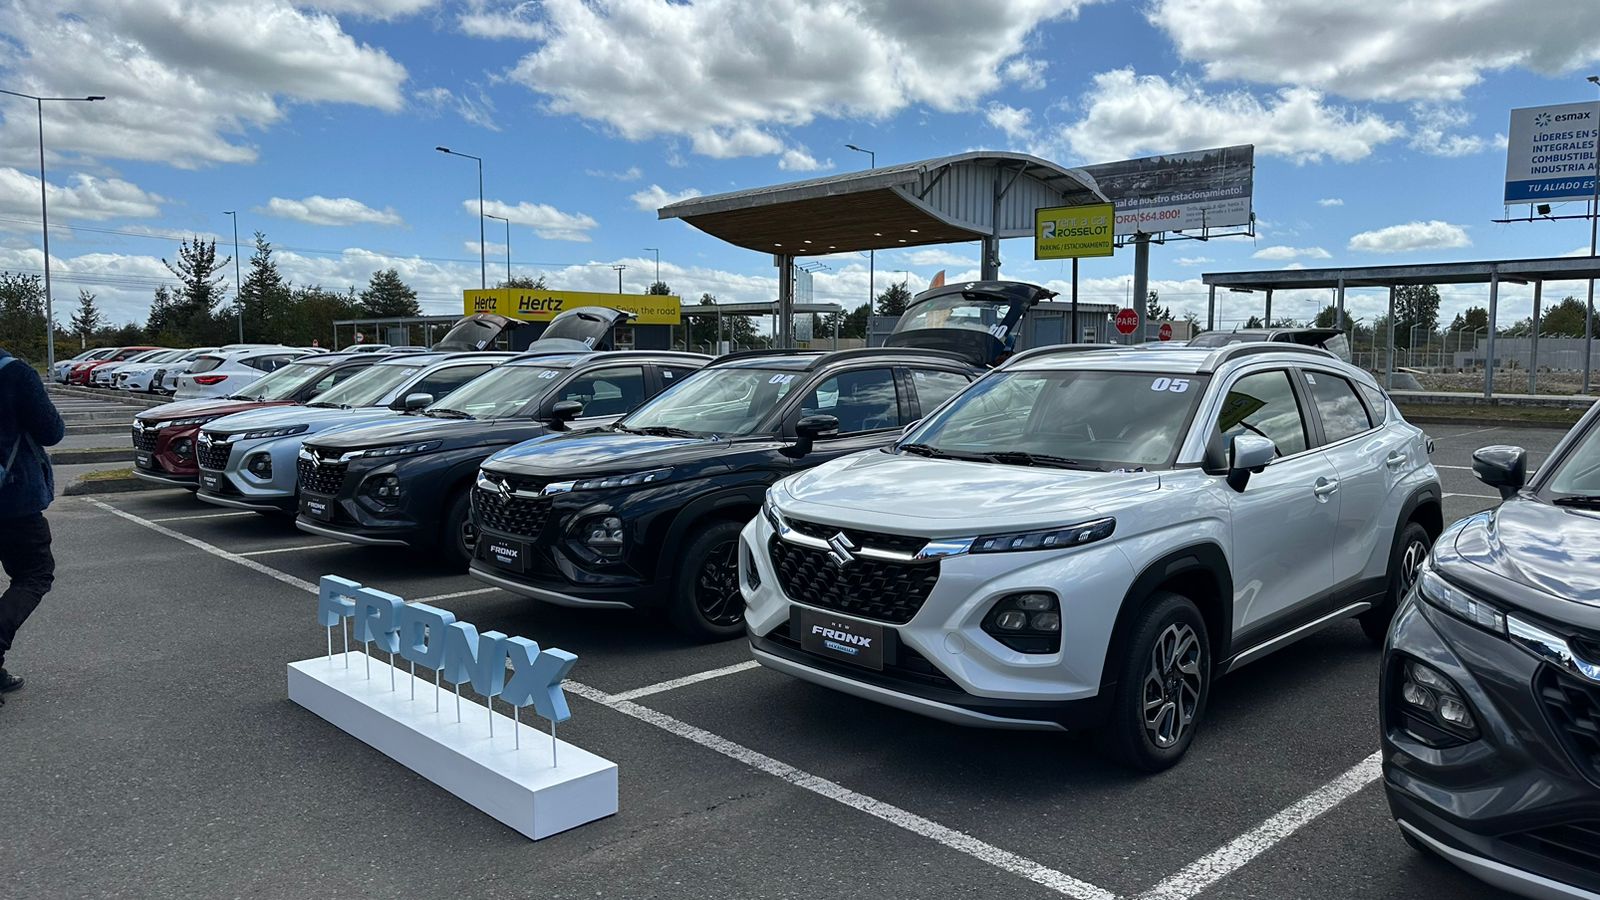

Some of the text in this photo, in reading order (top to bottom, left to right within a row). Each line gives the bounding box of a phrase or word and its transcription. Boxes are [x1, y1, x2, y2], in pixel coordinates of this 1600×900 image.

[1554, 111, 1591, 122] esmax
[1533, 130, 1574, 142] LÍDERES
[1576, 129, 1589, 139] EN
[1532, 141, 1594, 153] INTEGRALES
[1531, 163, 1585, 175] INDUSTRIA
[1528, 180, 1595, 192] TU ALIADO ES
[1128, 198, 1138, 207] de
[1139, 195, 1170, 205] nuestro
[1170, 186, 1243, 202] estacionamiento!
[1139, 209, 1180, 222] $64.800!
[1057, 225, 1108, 237] ROSSELOT
[474, 295, 497, 310] Hertz
[518, 295, 563, 311] Hertz
[641, 306, 655, 315] the
[1116, 316, 1138, 326] PARE
[1150, 377, 1190, 393] 05
[490, 544, 518, 557] FRONX
[811, 624, 872, 648] FRONX
[319, 574, 579, 723] FRONX
